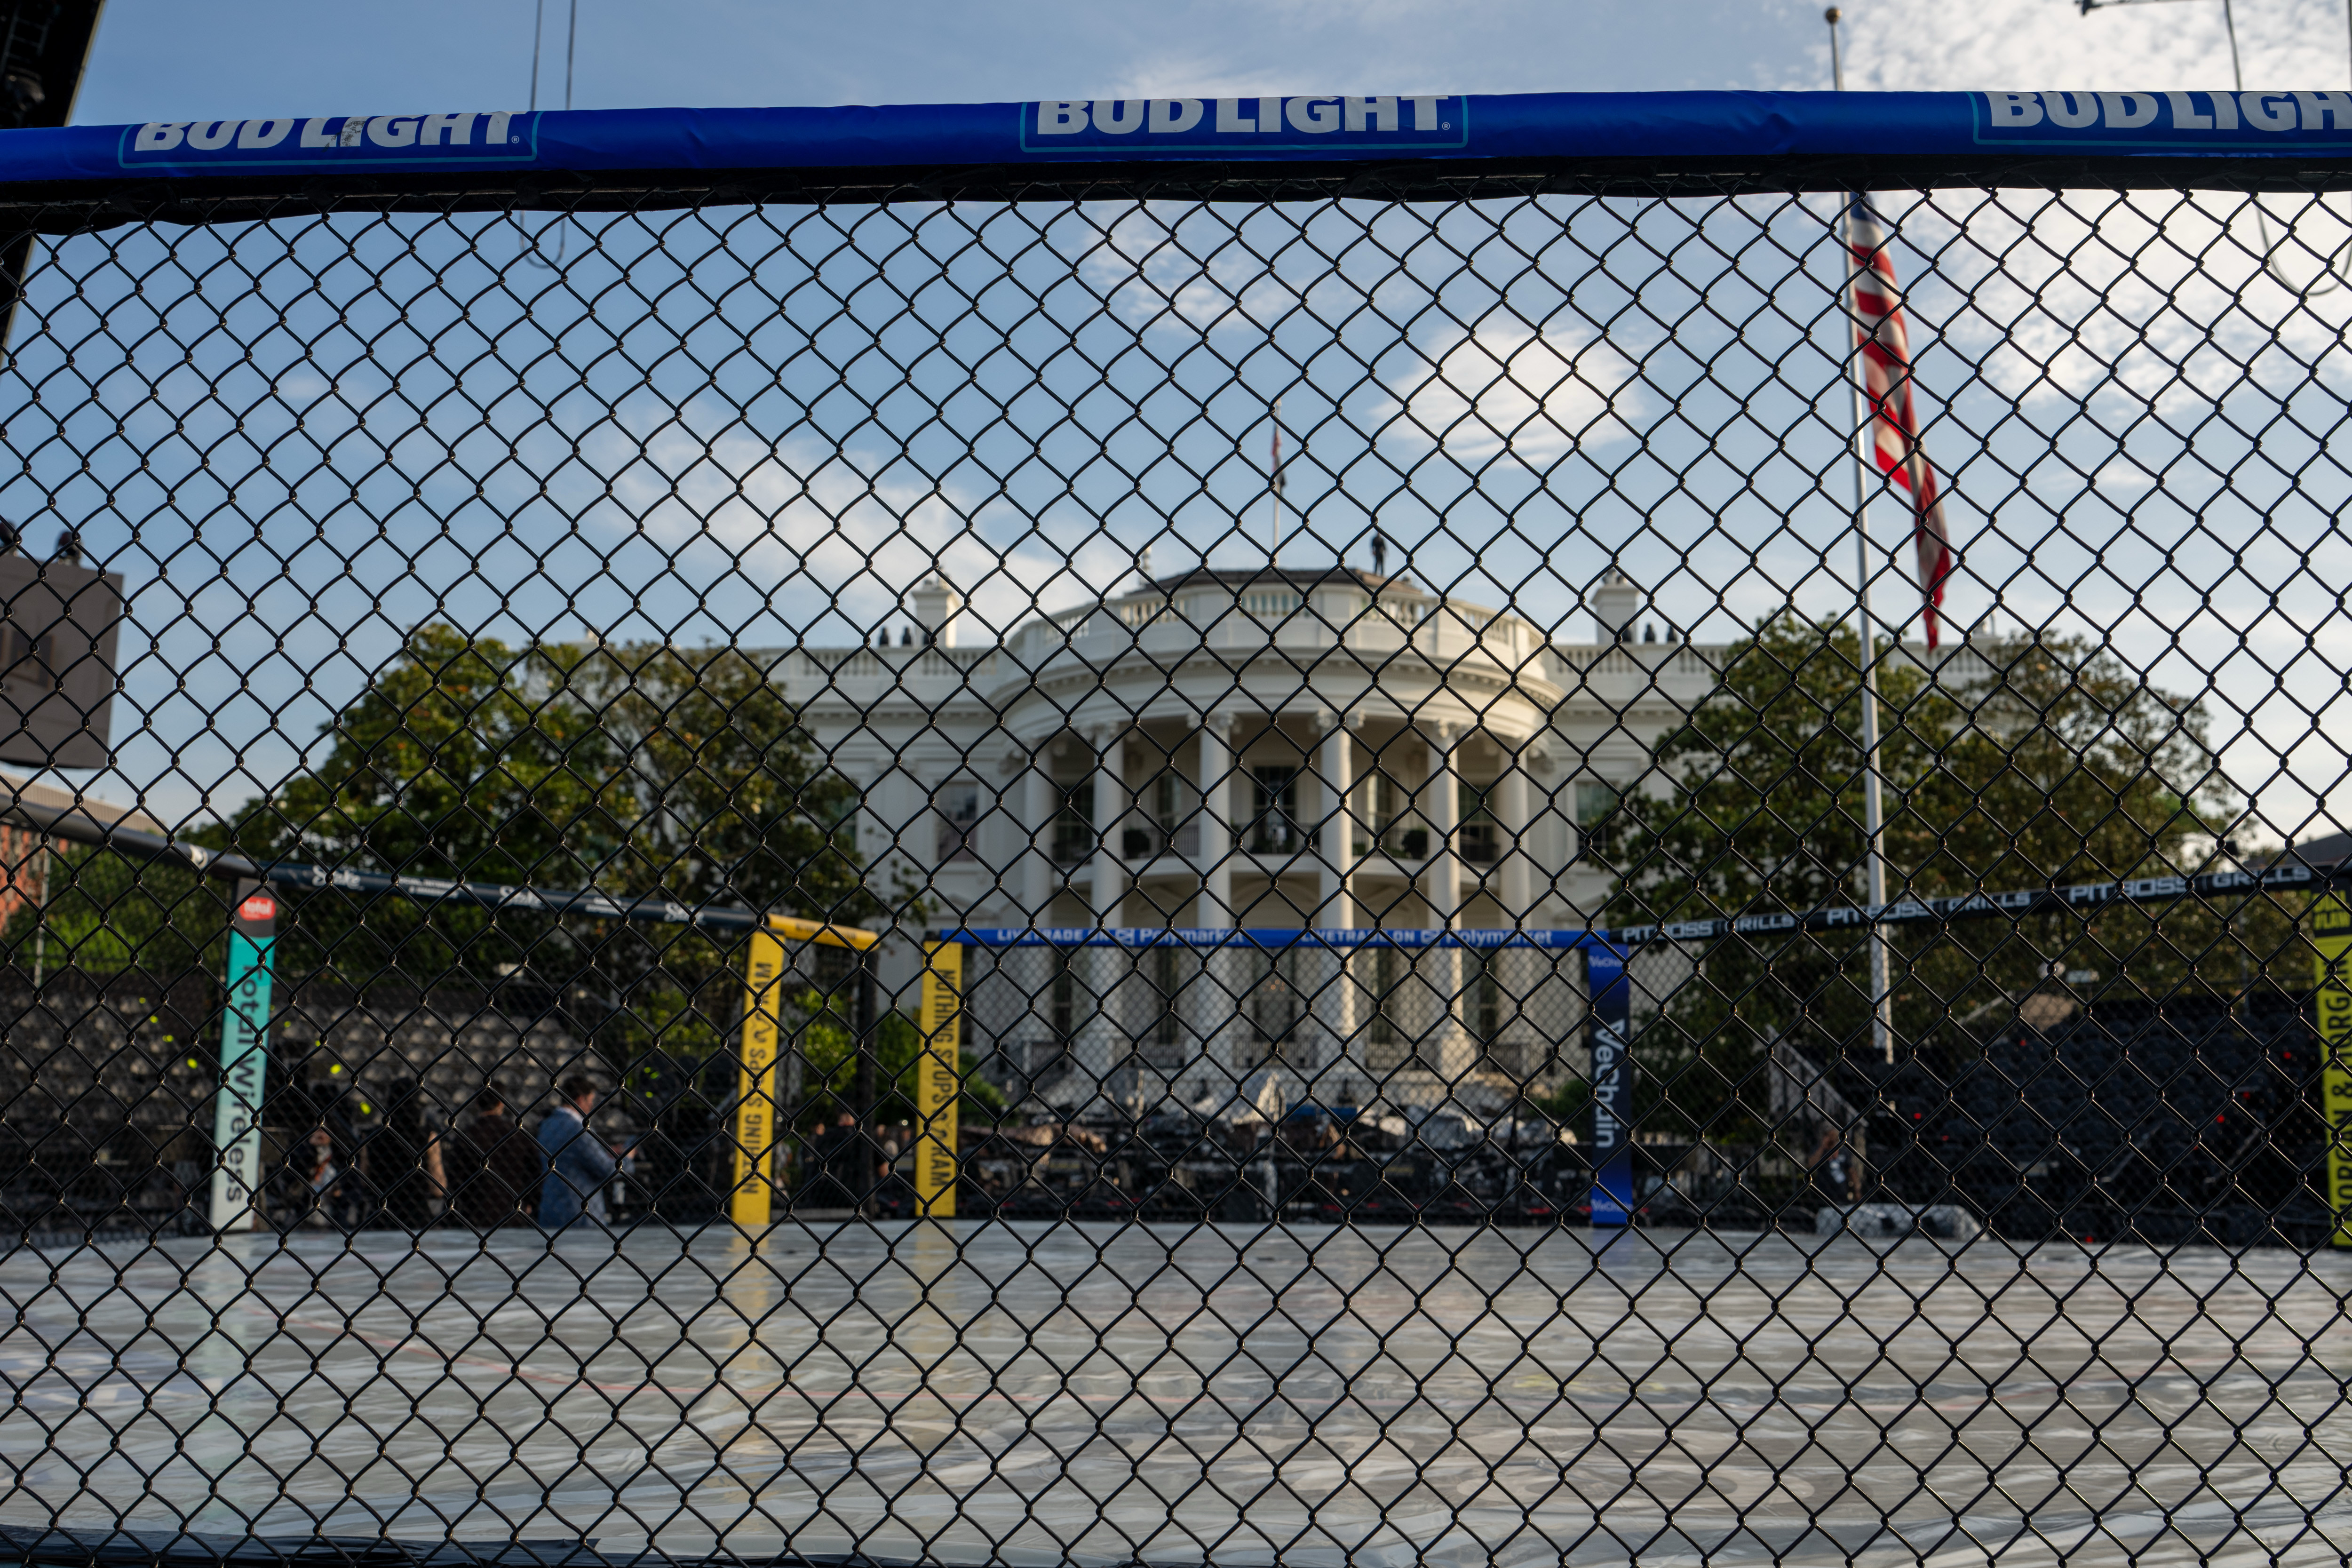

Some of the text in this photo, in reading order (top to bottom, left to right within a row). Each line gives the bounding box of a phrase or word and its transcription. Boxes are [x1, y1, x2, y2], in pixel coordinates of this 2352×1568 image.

[1038, 98, 1203, 135] BUD
[1983, 91, 2352, 132] BUD LIGH
[135, 119, 295, 151] BUD
[2212, 867, 2311, 888] GRLLS
[754, 962, 772, 1003] AM
[226, 962, 262, 1202] Total Wireless
[746, 1048, 767, 1108] SPS
[1595, 1018, 1625, 1148] VeChain
